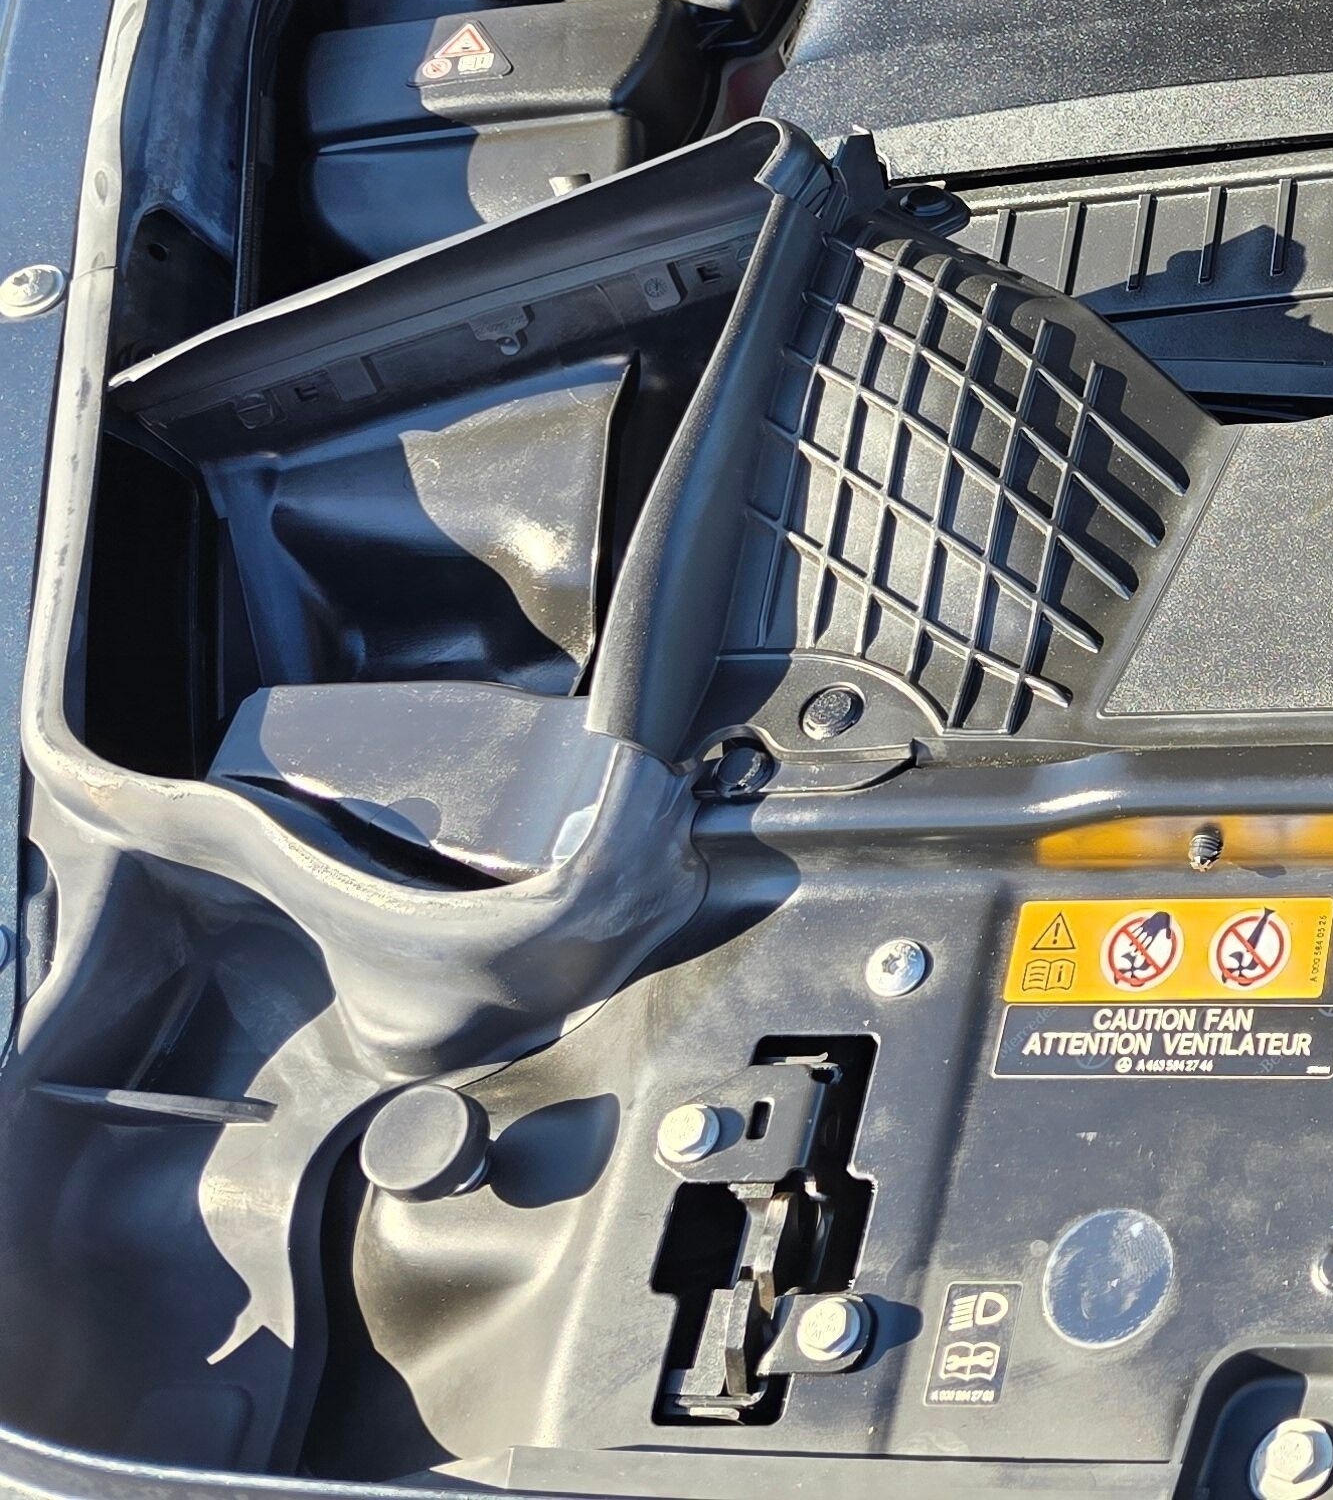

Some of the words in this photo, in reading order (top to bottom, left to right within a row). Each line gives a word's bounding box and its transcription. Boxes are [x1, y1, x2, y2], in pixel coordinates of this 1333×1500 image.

[1311, 958, 1321, 974] 000
[1309, 975, 1318, 983] A
[1093, 1008, 1197, 1032] CAUTION
[1204, 1008, 1254, 1032] FAN
[1022, 1032, 1153, 1057] ATTENTION
[1162, 1032, 1313, 1057] VENTILATEUR
[1135, 1059, 1145, 1072] A
